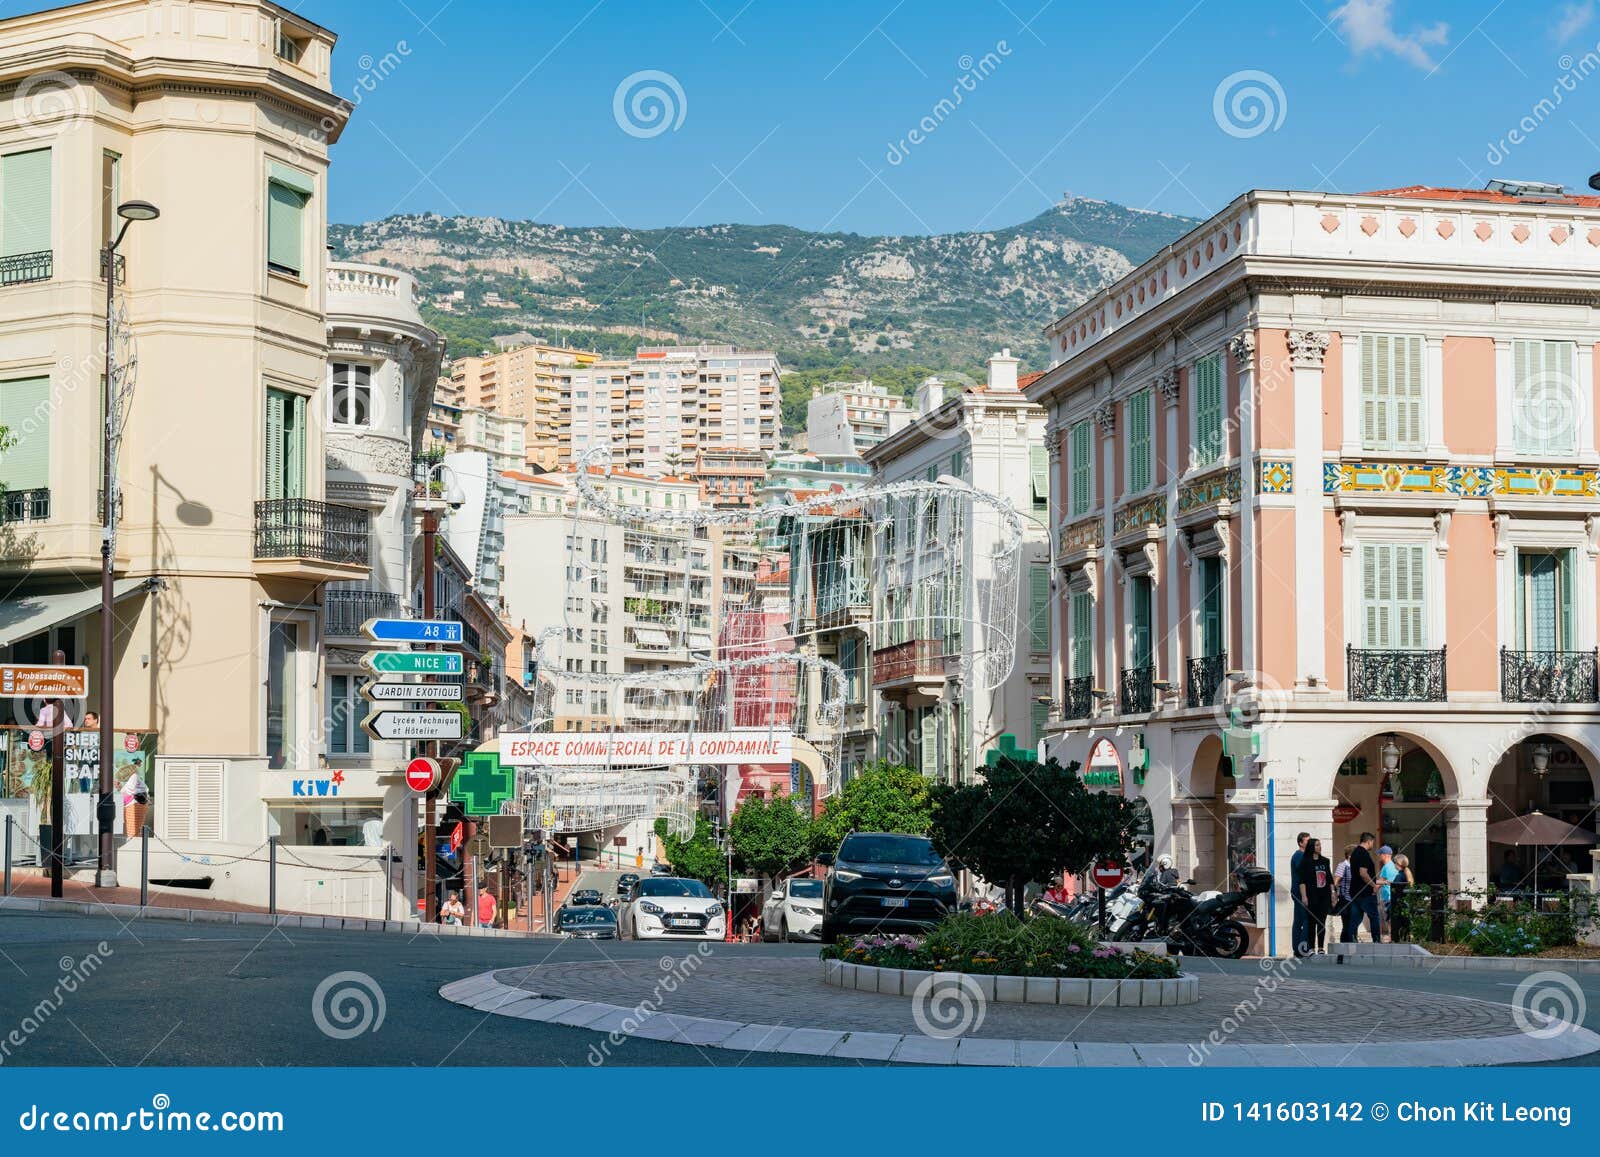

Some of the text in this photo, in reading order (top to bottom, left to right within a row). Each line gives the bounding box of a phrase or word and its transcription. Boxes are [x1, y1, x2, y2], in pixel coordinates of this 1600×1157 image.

[424, 625, 440, 637] A8
[414, 658, 440, 669] NICE
[16, 671, 66, 680] Ambassador
[16, 681, 71, 691] Le Versailles
[379, 687, 459, 697] JARDIN EXOTIQUE
[392, 715, 459, 726] Lycée Technique
[392, 726, 438, 735] et Hôtelier
[65, 732, 99, 746] BIER
[511, 740, 780, 756] ESPACE COMMERCIAL DE LA CONDAMINE
